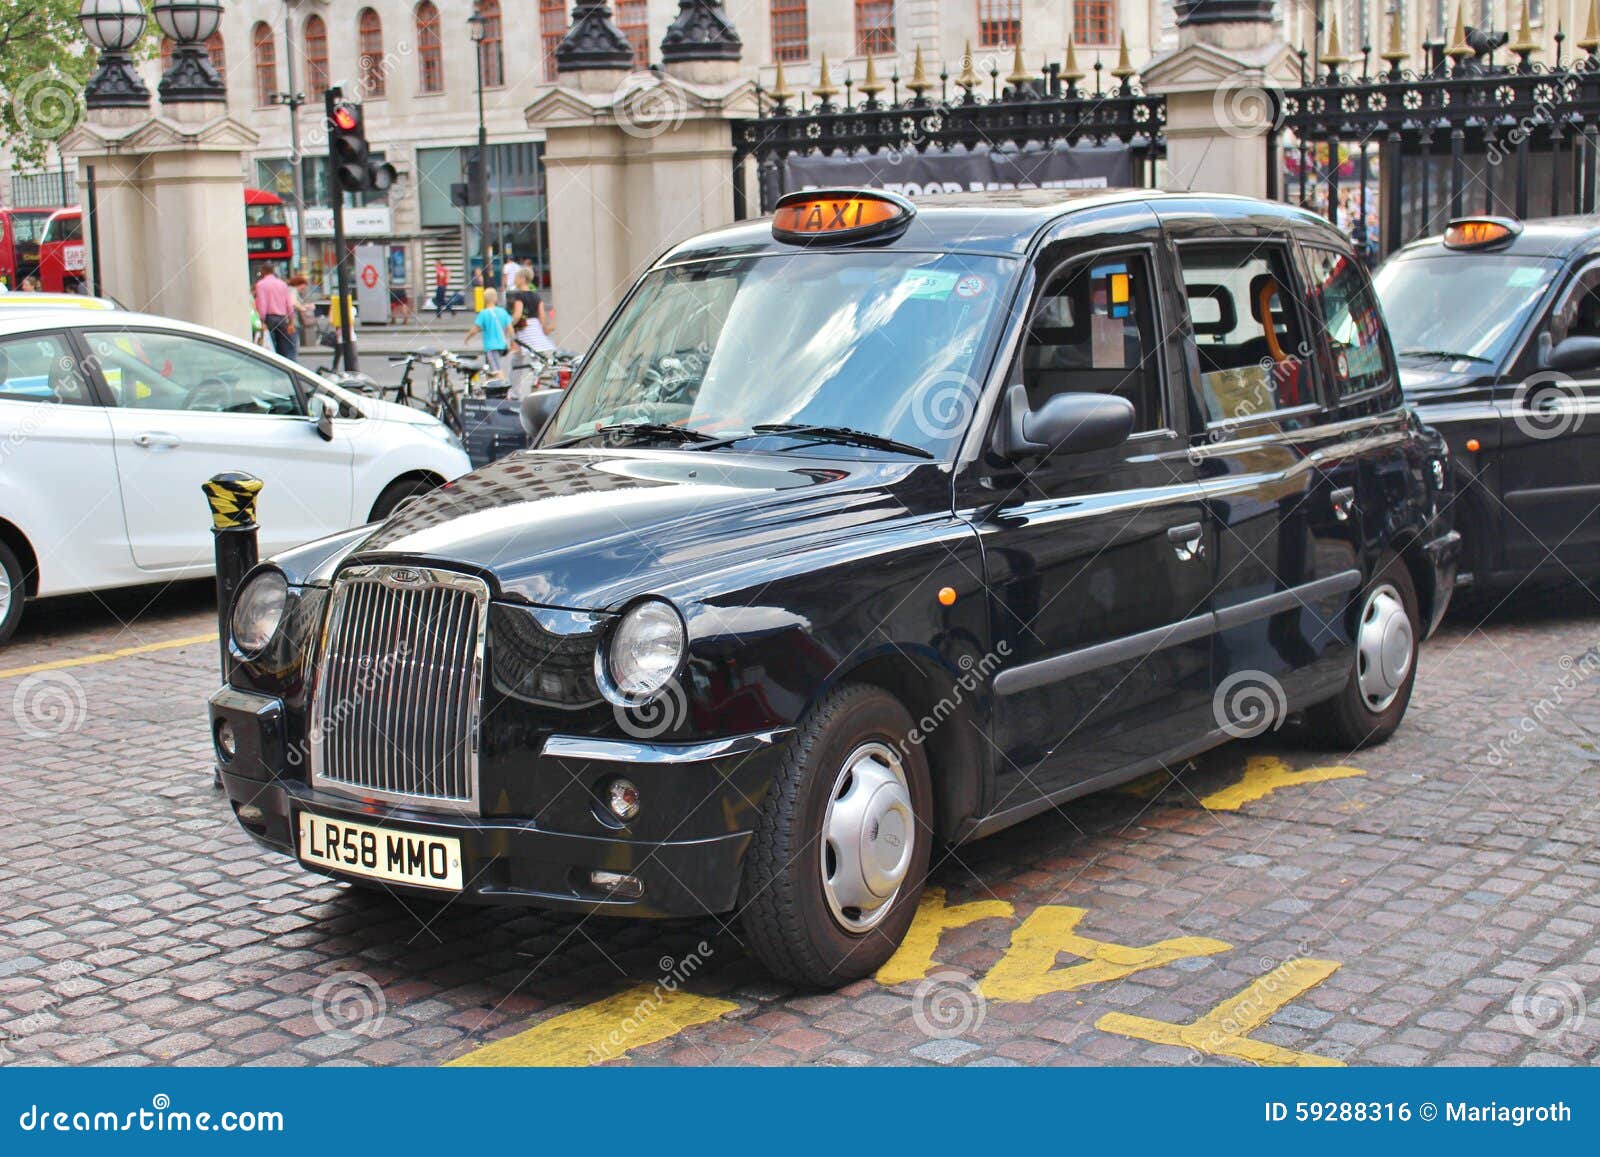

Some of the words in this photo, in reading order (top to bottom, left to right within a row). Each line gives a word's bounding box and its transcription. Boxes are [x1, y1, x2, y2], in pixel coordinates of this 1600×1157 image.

[791, 202, 864, 230] TAXI
[310, 819, 377, 869] LR58
[386, 835, 448, 880] MMO
